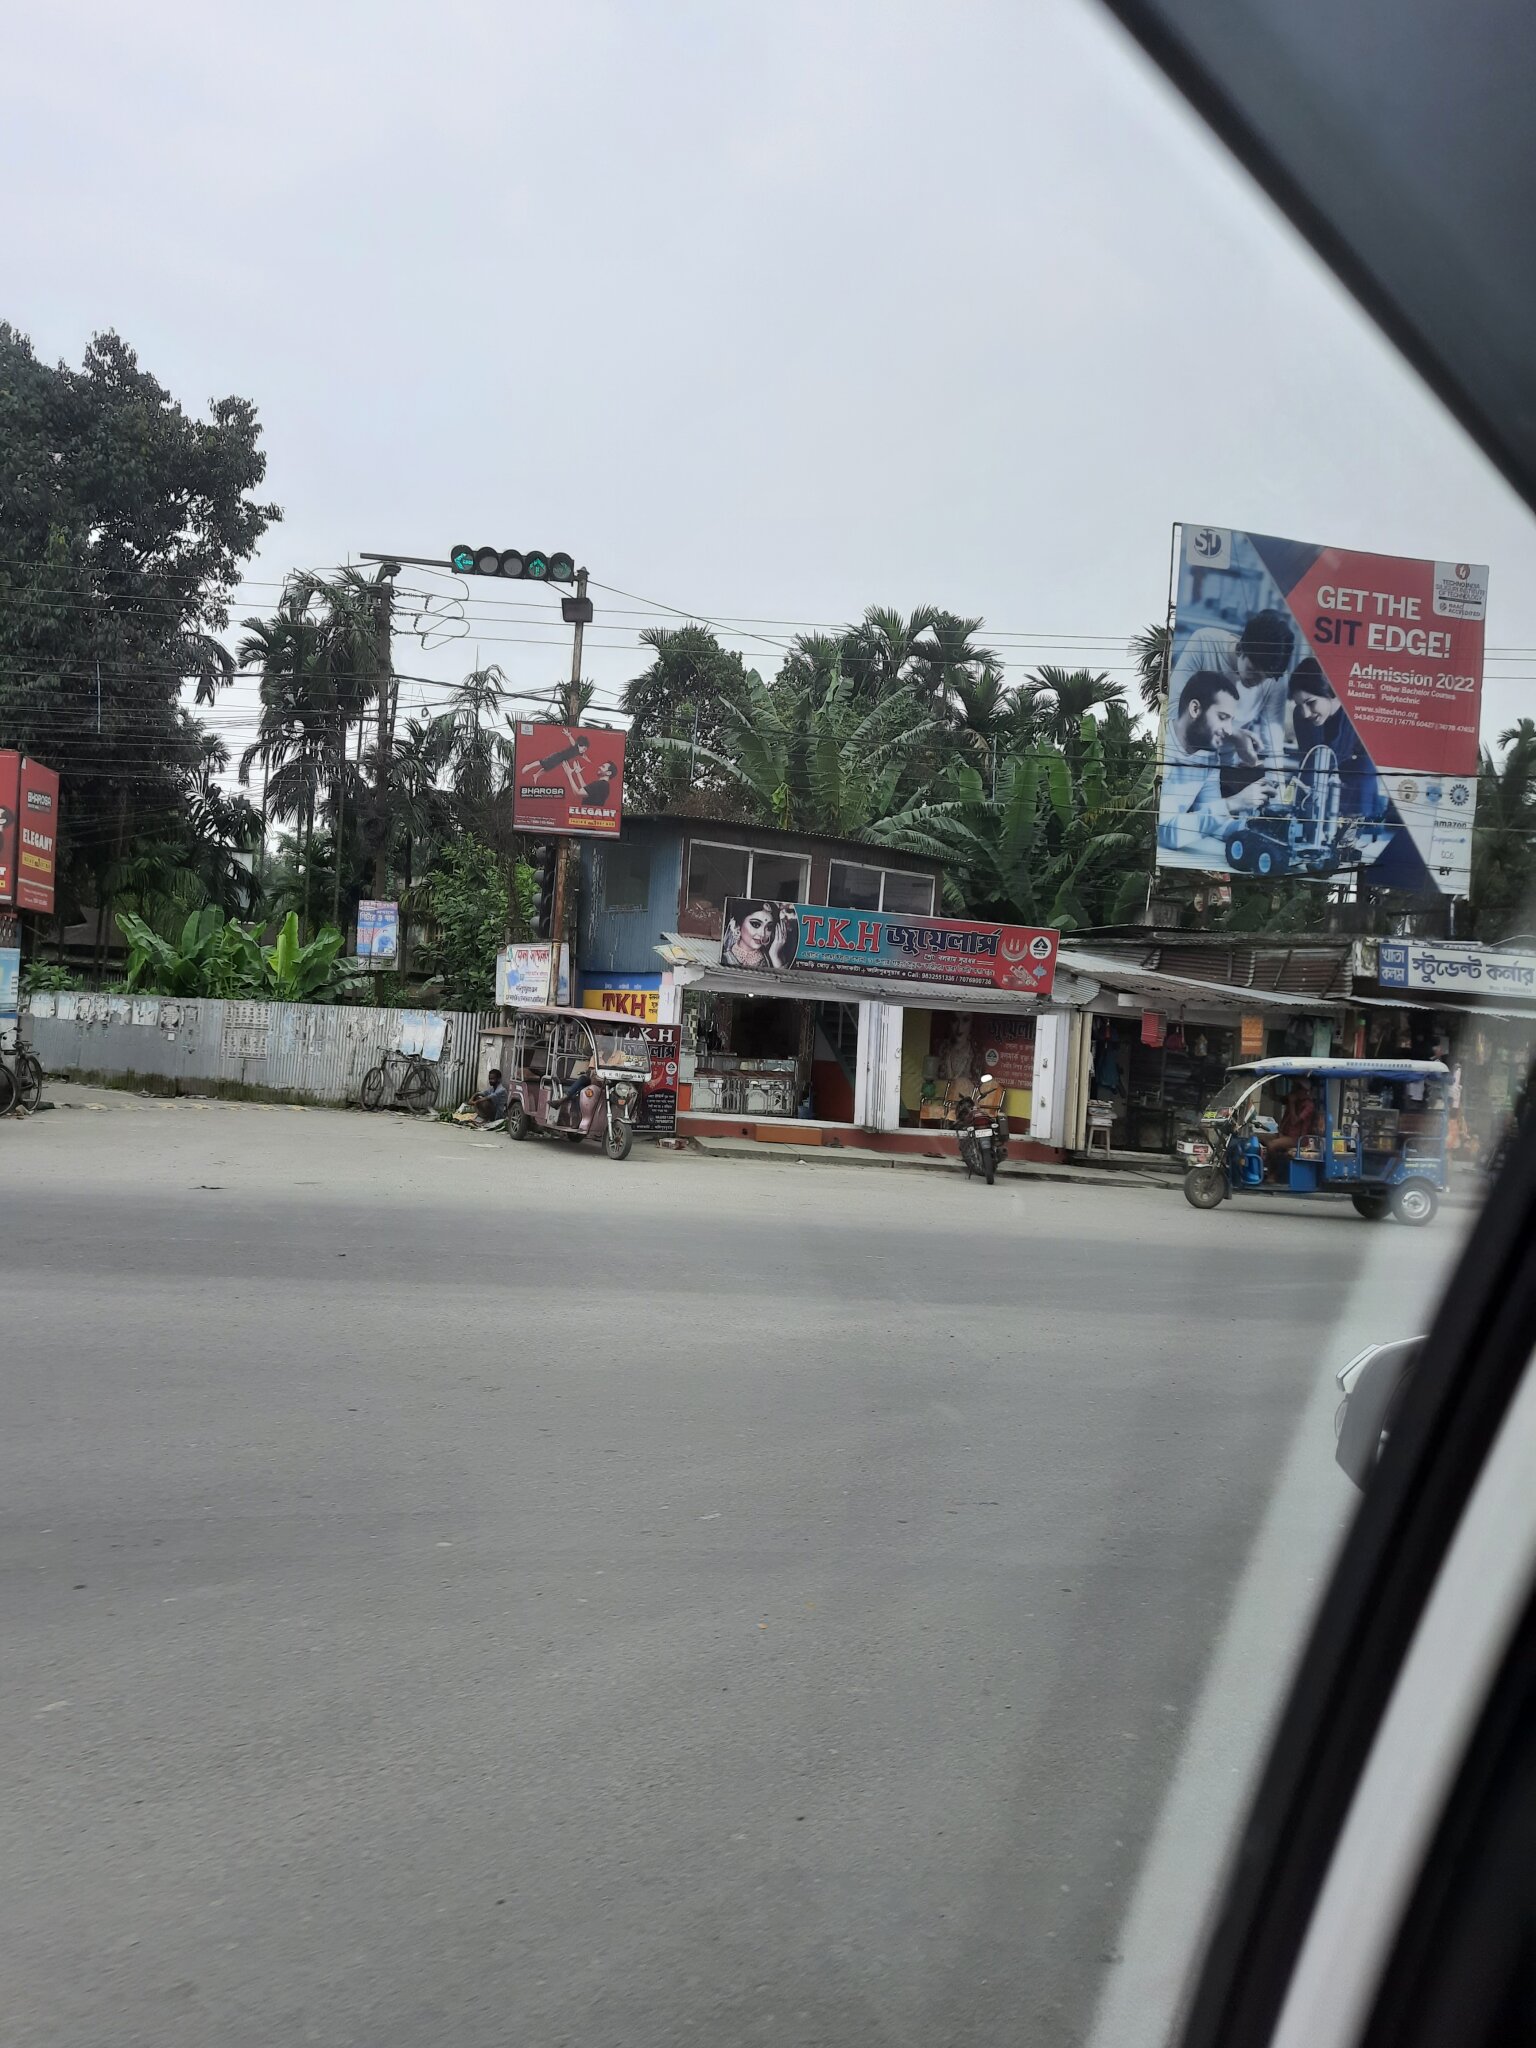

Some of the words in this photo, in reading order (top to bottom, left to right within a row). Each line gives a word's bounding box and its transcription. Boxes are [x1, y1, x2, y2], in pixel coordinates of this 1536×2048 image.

[1317, 585, 1369, 613] GET
[1372, 591, 1422, 620] THE
[1314, 616, 1362, 646] SIT
[1367, 623, 1452, 658] EDGE!
[1350, 662, 1433, 688] Admission
[1436, 673, 1475, 692] 2022
[1347, 689, 1376, 700] Masters
[1381, 693, 1420, 705] Polytechnic
[1357, 681, 1374, 690] Tech.
[1380, 684, 1401, 693] Other
[1401, 686, 1430, 696] Bachelor
[1431, 690, 1456, 700] Courses
[521, 787, 564, 796] BHAROSA
[568, 806, 617, 818] ELEGANT
[1433, 820, 1467, 829] amazon
[22, 827, 53, 852] ELEGANT
[801, 914, 883, 953] T.K.H
[885, 923, 1003, 956] জুয়েলার্স
[1381, 947, 1405, 964] খাতা
[1381, 966, 1405, 982] কলম
[1411, 951, 1483, 984] স্টুডেন্ট
[1485, 960, 1535, 986] কর্নার
[602, 993, 648, 1019] TKH
